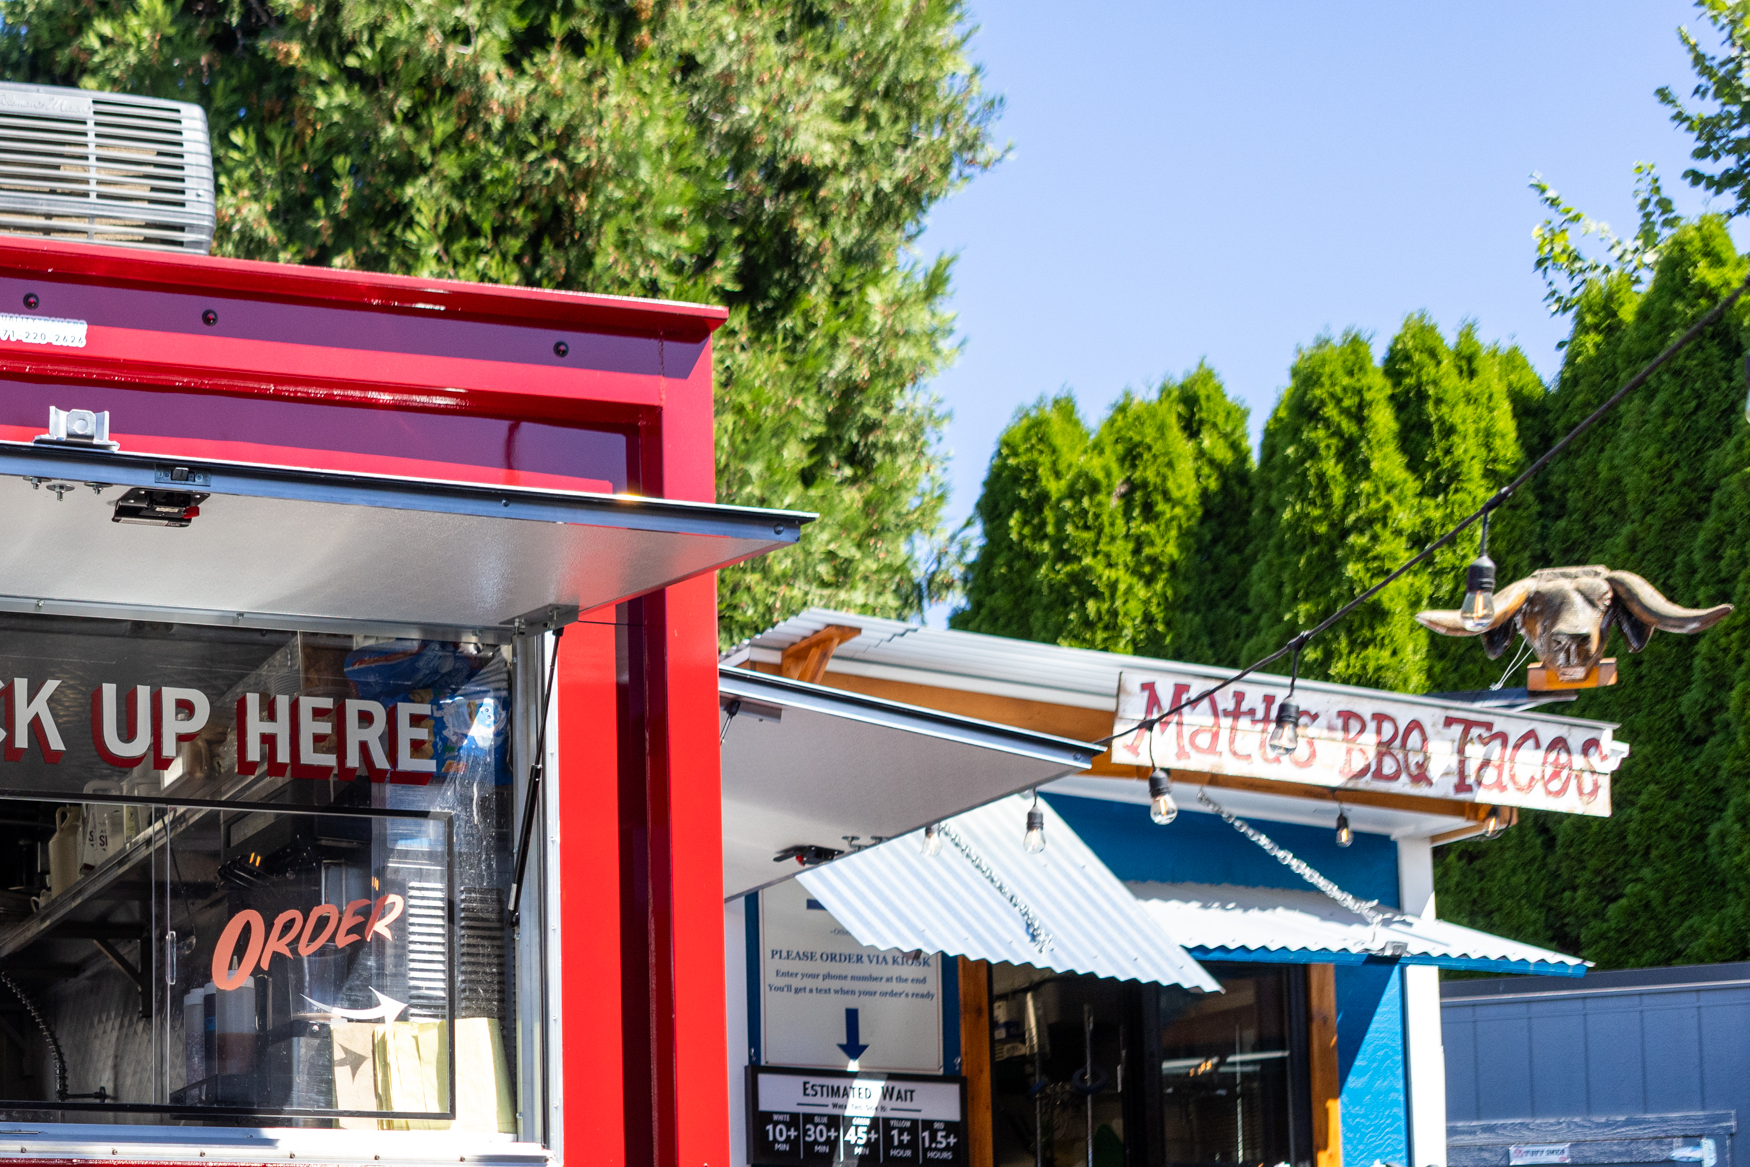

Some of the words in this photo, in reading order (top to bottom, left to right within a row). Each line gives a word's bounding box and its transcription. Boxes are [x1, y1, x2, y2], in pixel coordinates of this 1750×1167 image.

[92, 682, 211, 770] UP
[236, 692, 437, 785] HERE
[1123, 681, 1319, 768] Matts
[1337, 709, 1433, 787] BBQ
[1443, 716, 1609, 804] Tacos
[211, 893, 405, 991] ORDER
[771, 949, 817, 962] PLEASE
[820, 951, 864, 964] ORDER
[867, 954, 889, 966] VIA
[892, 955, 932, 967] KIOSK
[776, 969, 799, 979] Enter
[801, 972, 821, 981] your
[822, 971, 848, 983] phone
[850, 972, 884, 983] number
[885, 974, 894, 983] at
[895, 974, 909, 984] the
[911, 976, 927, 985] end
[768, 983, 792, 993] You'll
[794, 985, 807, 995] get
[815, 985, 831, 994] text
[833, 986, 856, 996] when
[858, 988, 877, 998] your
[879, 988, 909, 998] order's
[911, 990, 935, 1000] ready
[803, 1080, 872, 1100] ESTIMATED
[881, 1085, 916, 1103] WAIT
[773, 1114, 790, 1122] WHITE
[814, 1116, 828, 1124] BLUE
[890, 1119, 911, 1128] YELLOW
[765, 1124, 798, 1142] 10+
[805, 1125, 838, 1143] 30+
[844, 1126, 878, 1145] 45+
[890, 1129, 911, 1147] 1+
[922, 1130, 958, 1149] 1.5+
[775, 1143, 789, 1151] MIN
[814, 1145, 829, 1153] MIN
[854, 1146, 869, 1155] MIN
[890, 1149, 912, 1157] HOUR
[927, 1151, 953, 1159] HOURS
